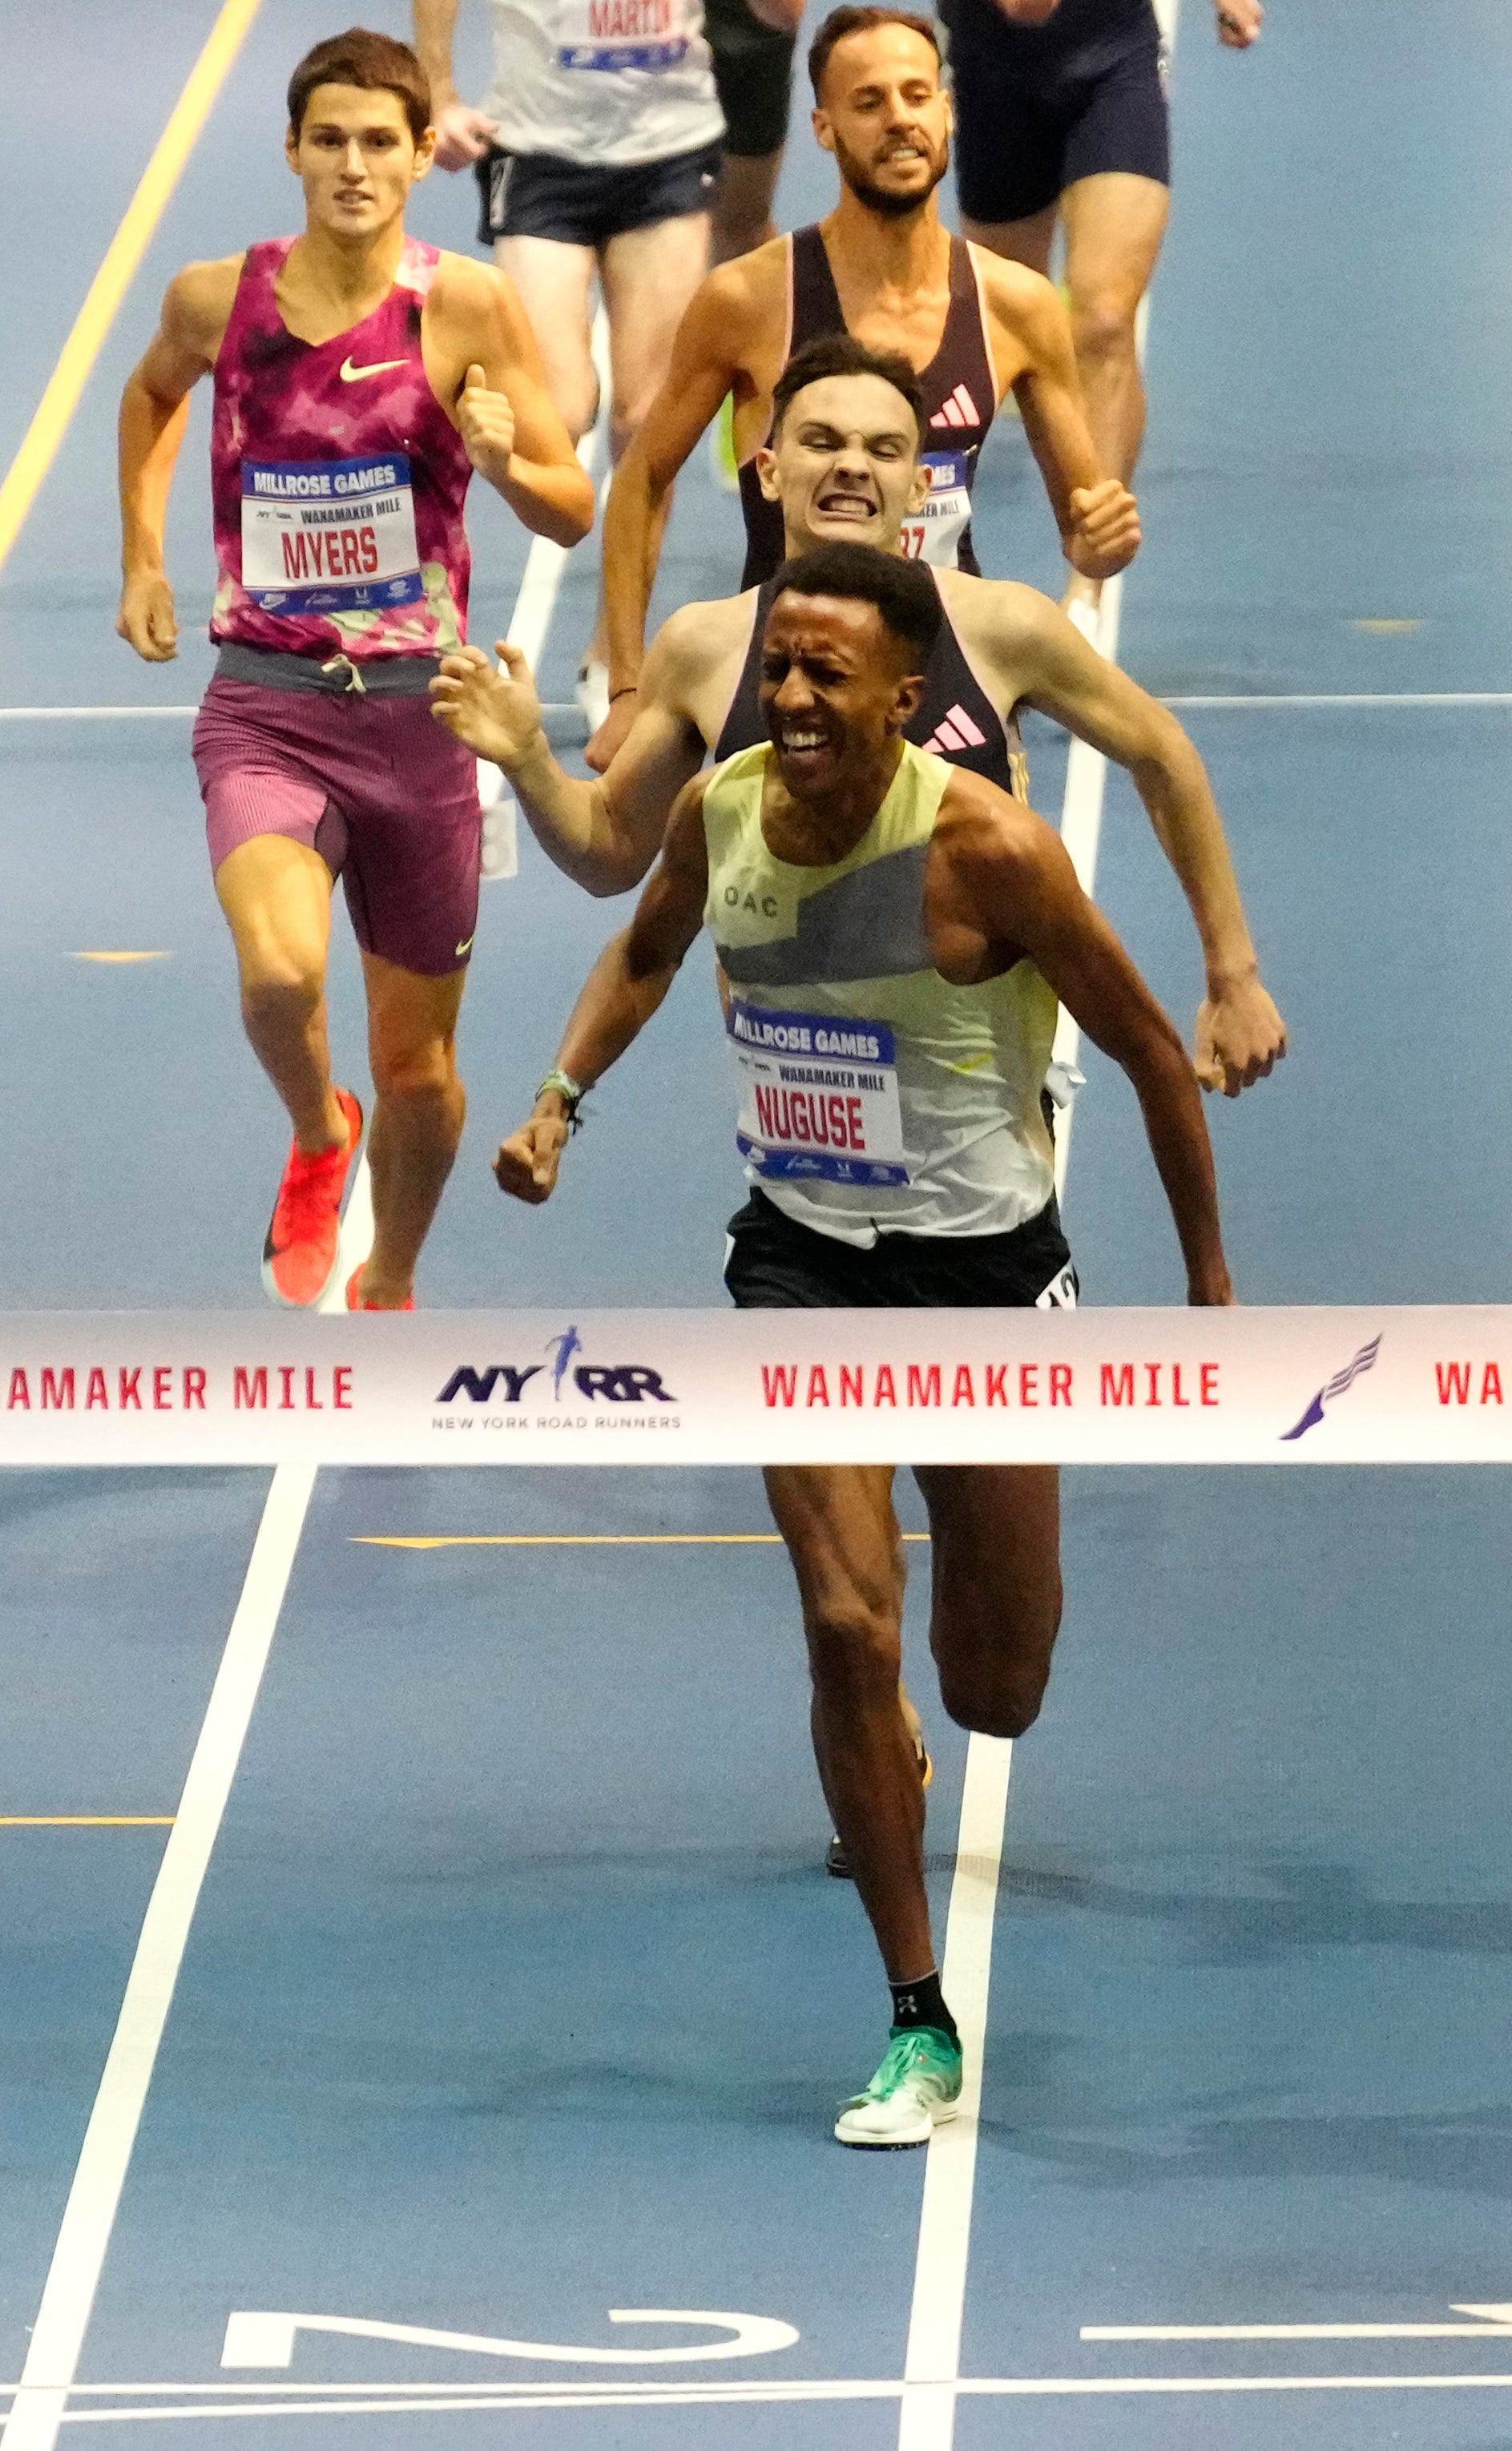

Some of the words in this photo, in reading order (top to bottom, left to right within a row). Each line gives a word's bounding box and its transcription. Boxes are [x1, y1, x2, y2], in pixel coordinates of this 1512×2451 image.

[254, 471, 331, 495] MILLROSE
[334, 465, 396, 494] GAMES
[300, 502, 373, 524] WANAMAKER
[376, 497, 400, 515] MILE
[281, 526, 378, 579] MYERS
[724, 886, 778, 917] OAC
[735, 1013, 811, 1051] MILLROSE
[815, 1029, 879, 1058] GAMES
[779, 1064, 855, 1087] WANAMAKER
[858, 1073, 885, 1091] MILE
[756, 1084, 865, 1150] NUGUSE
[7, 1367, 208, 1409] AMAKER
[234, 1366, 353, 1409] MILE
[761, 1363, 1074, 1408] WANAMAKER
[1100, 1362, 1220, 1407] MILE
[1434, 1361, 1504, 1405] WA
[432, 1417, 474, 1429] NEW
[482, 1417, 530, 1429] YORK
[537, 1416, 588, 1429] ROAD
[595, 1417, 681, 1429] RUNNERS
